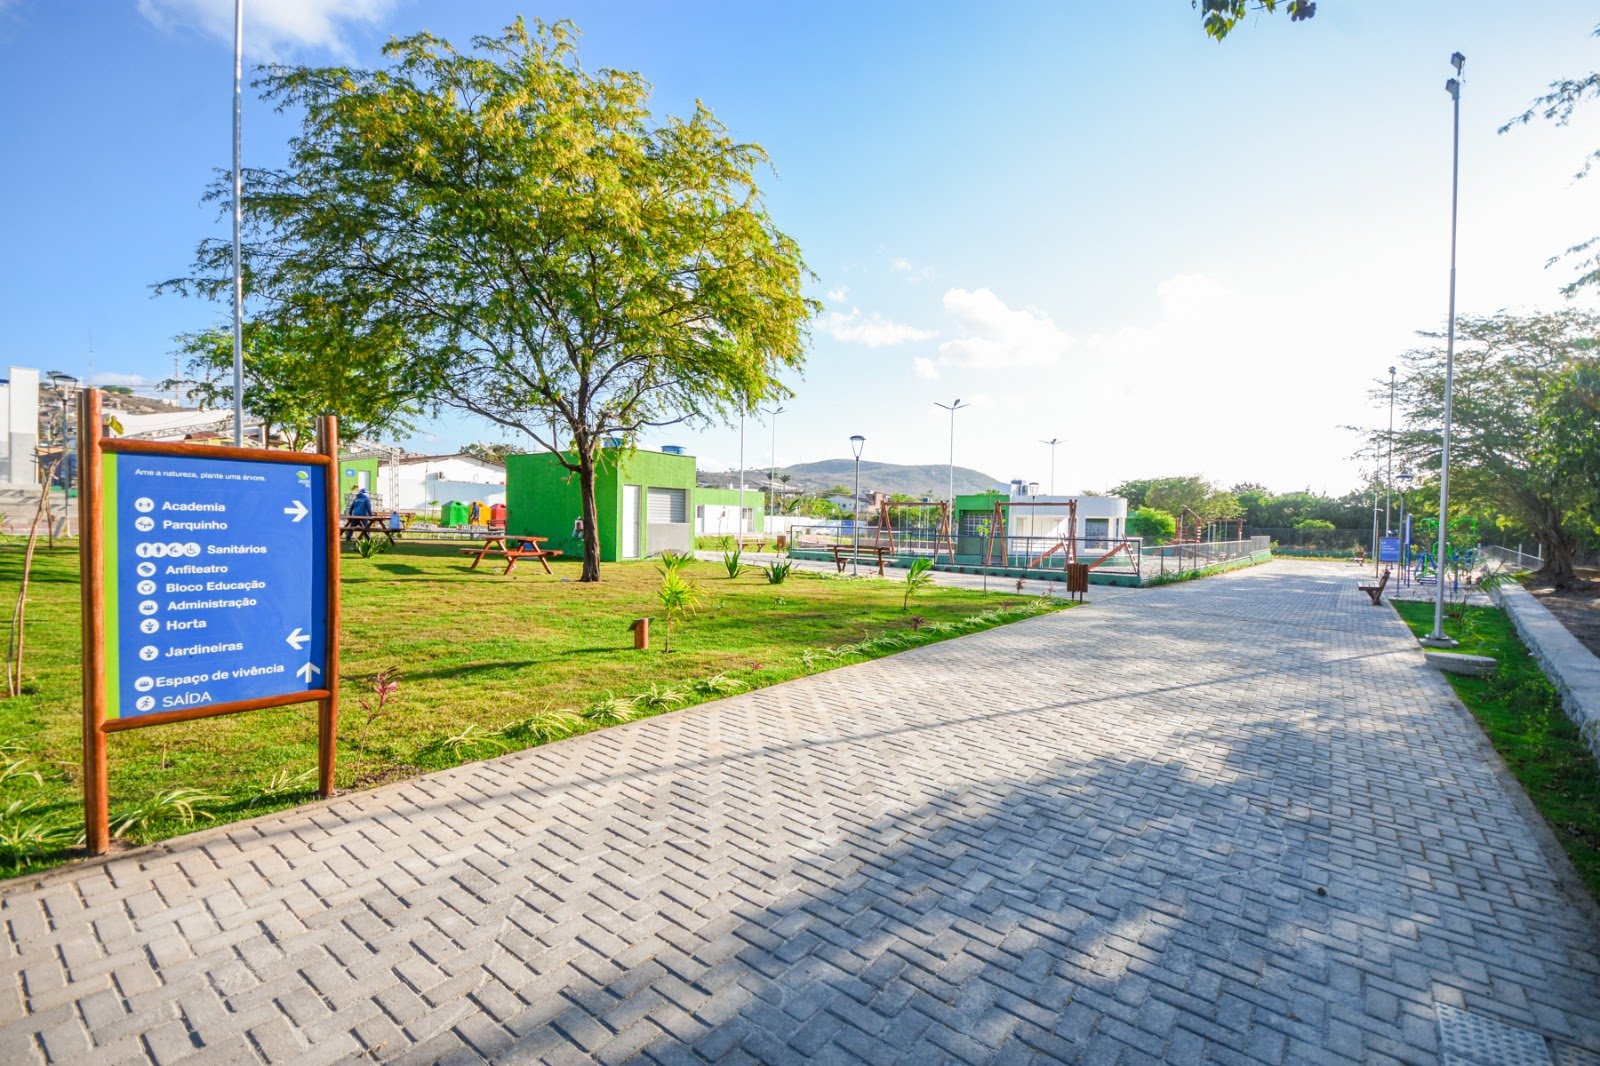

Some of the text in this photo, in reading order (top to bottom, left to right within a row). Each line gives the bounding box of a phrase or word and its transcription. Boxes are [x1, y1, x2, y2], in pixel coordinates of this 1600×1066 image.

[135, 468, 154, 476] Ame
[163, 470, 199, 479] natureza,
[200, 472, 224, 481] plante
[162, 501, 226, 512] Academia
[163, 520, 228, 532] Parquinho
[207, 544, 267, 555] Sanitários
[165, 564, 228, 575] Anfiteatro
[166, 580, 266, 593] Bloco Educação
[167, 597, 257, 612] Administração
[166, 619, 207, 631] Horta
[165, 641, 244, 658] Jardineiras
[155, 663, 285, 688] Espaço de vivência
[162, 691, 212, 708] SAÍDA
